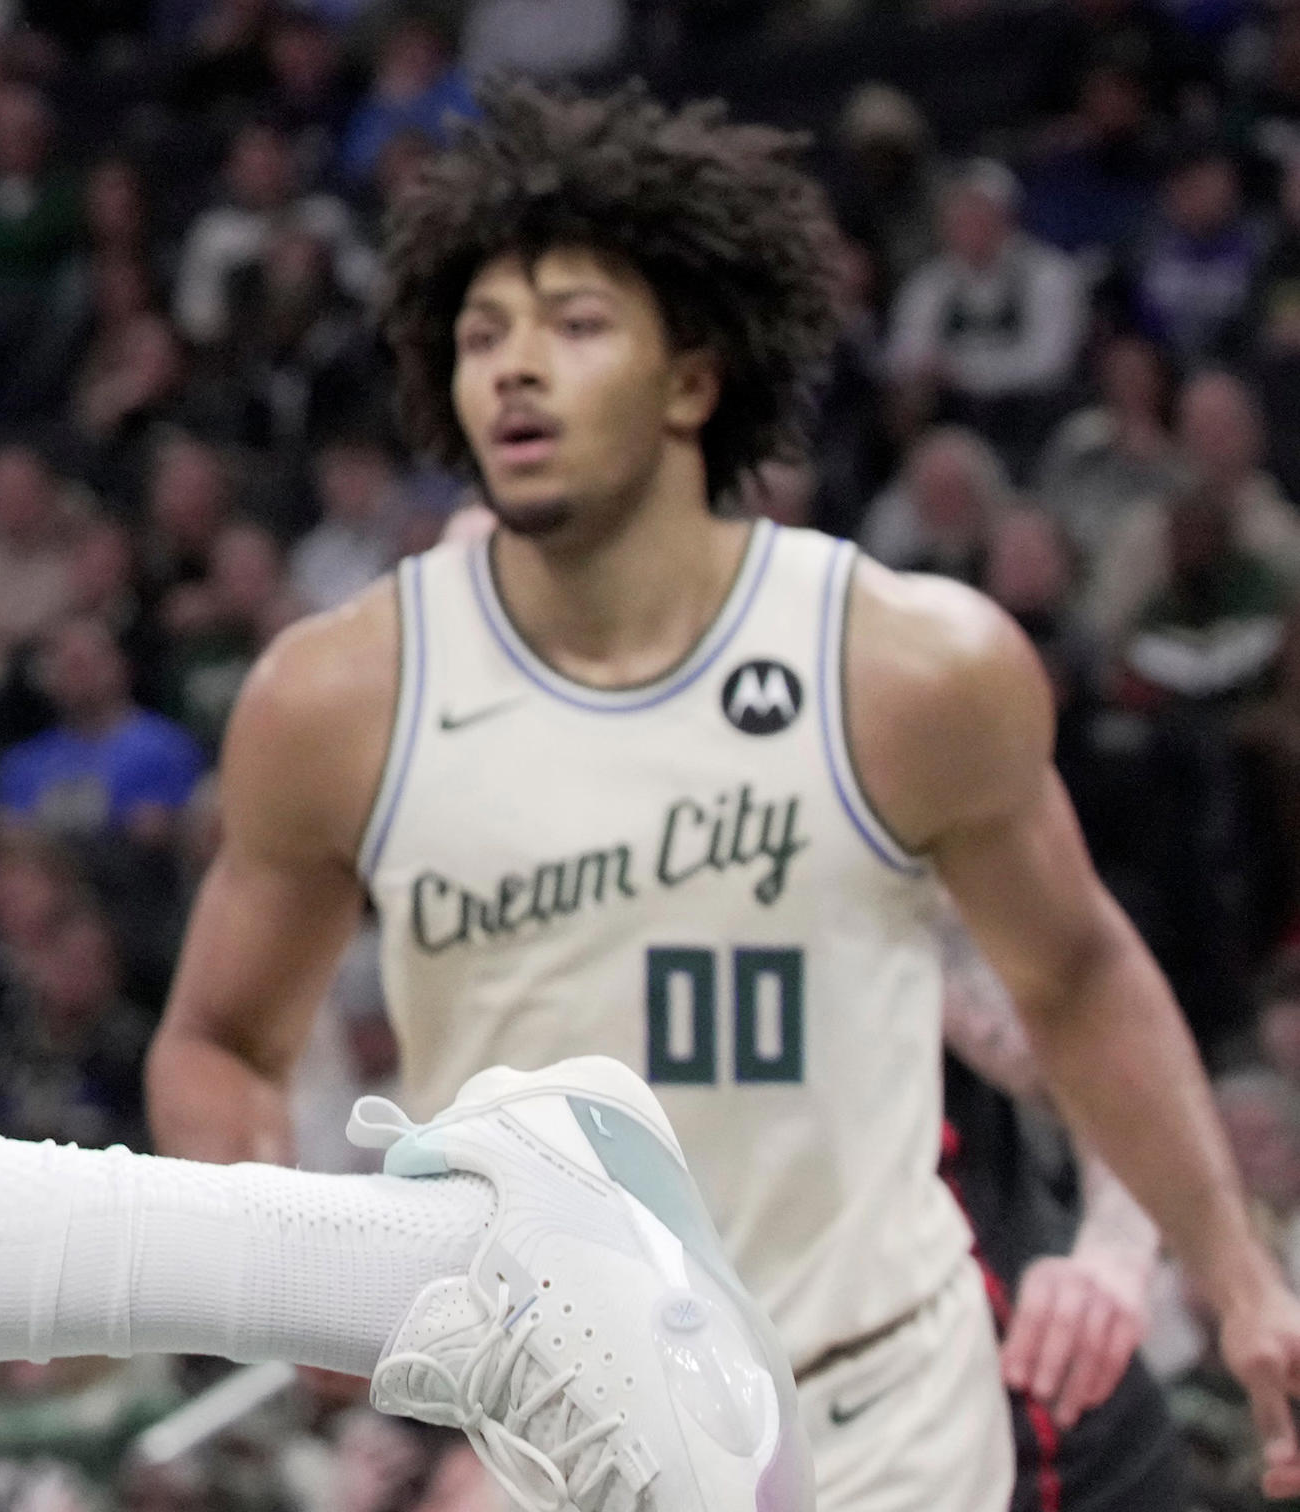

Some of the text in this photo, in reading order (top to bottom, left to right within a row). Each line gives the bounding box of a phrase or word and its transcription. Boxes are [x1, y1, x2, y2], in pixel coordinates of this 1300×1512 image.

[410, 784, 808, 955] Cream City
[646, 945, 806, 1086] 00
